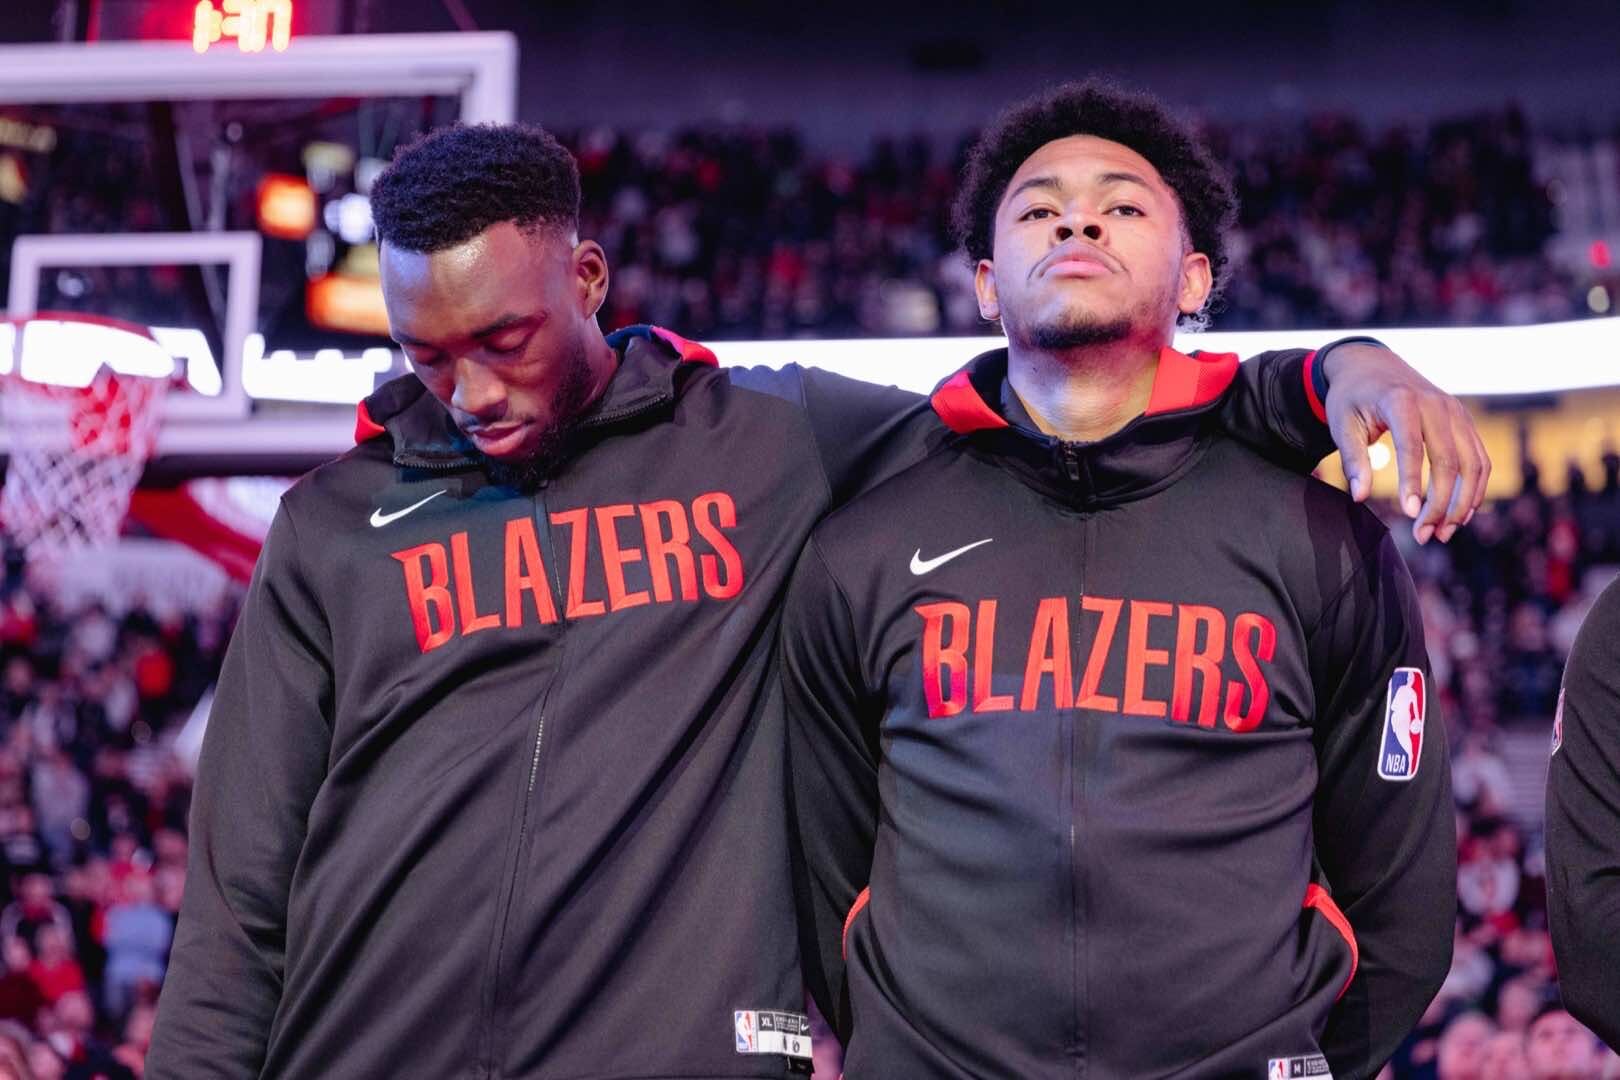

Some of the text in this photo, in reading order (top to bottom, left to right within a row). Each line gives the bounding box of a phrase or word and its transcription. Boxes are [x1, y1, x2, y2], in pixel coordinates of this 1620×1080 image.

[390, 491, 745, 655] BLAZERS
[914, 596, 1277, 733] BLAZERS
[1385, 753, 1406, 773] NBA
[761, 1016, 773, 1027] XL
